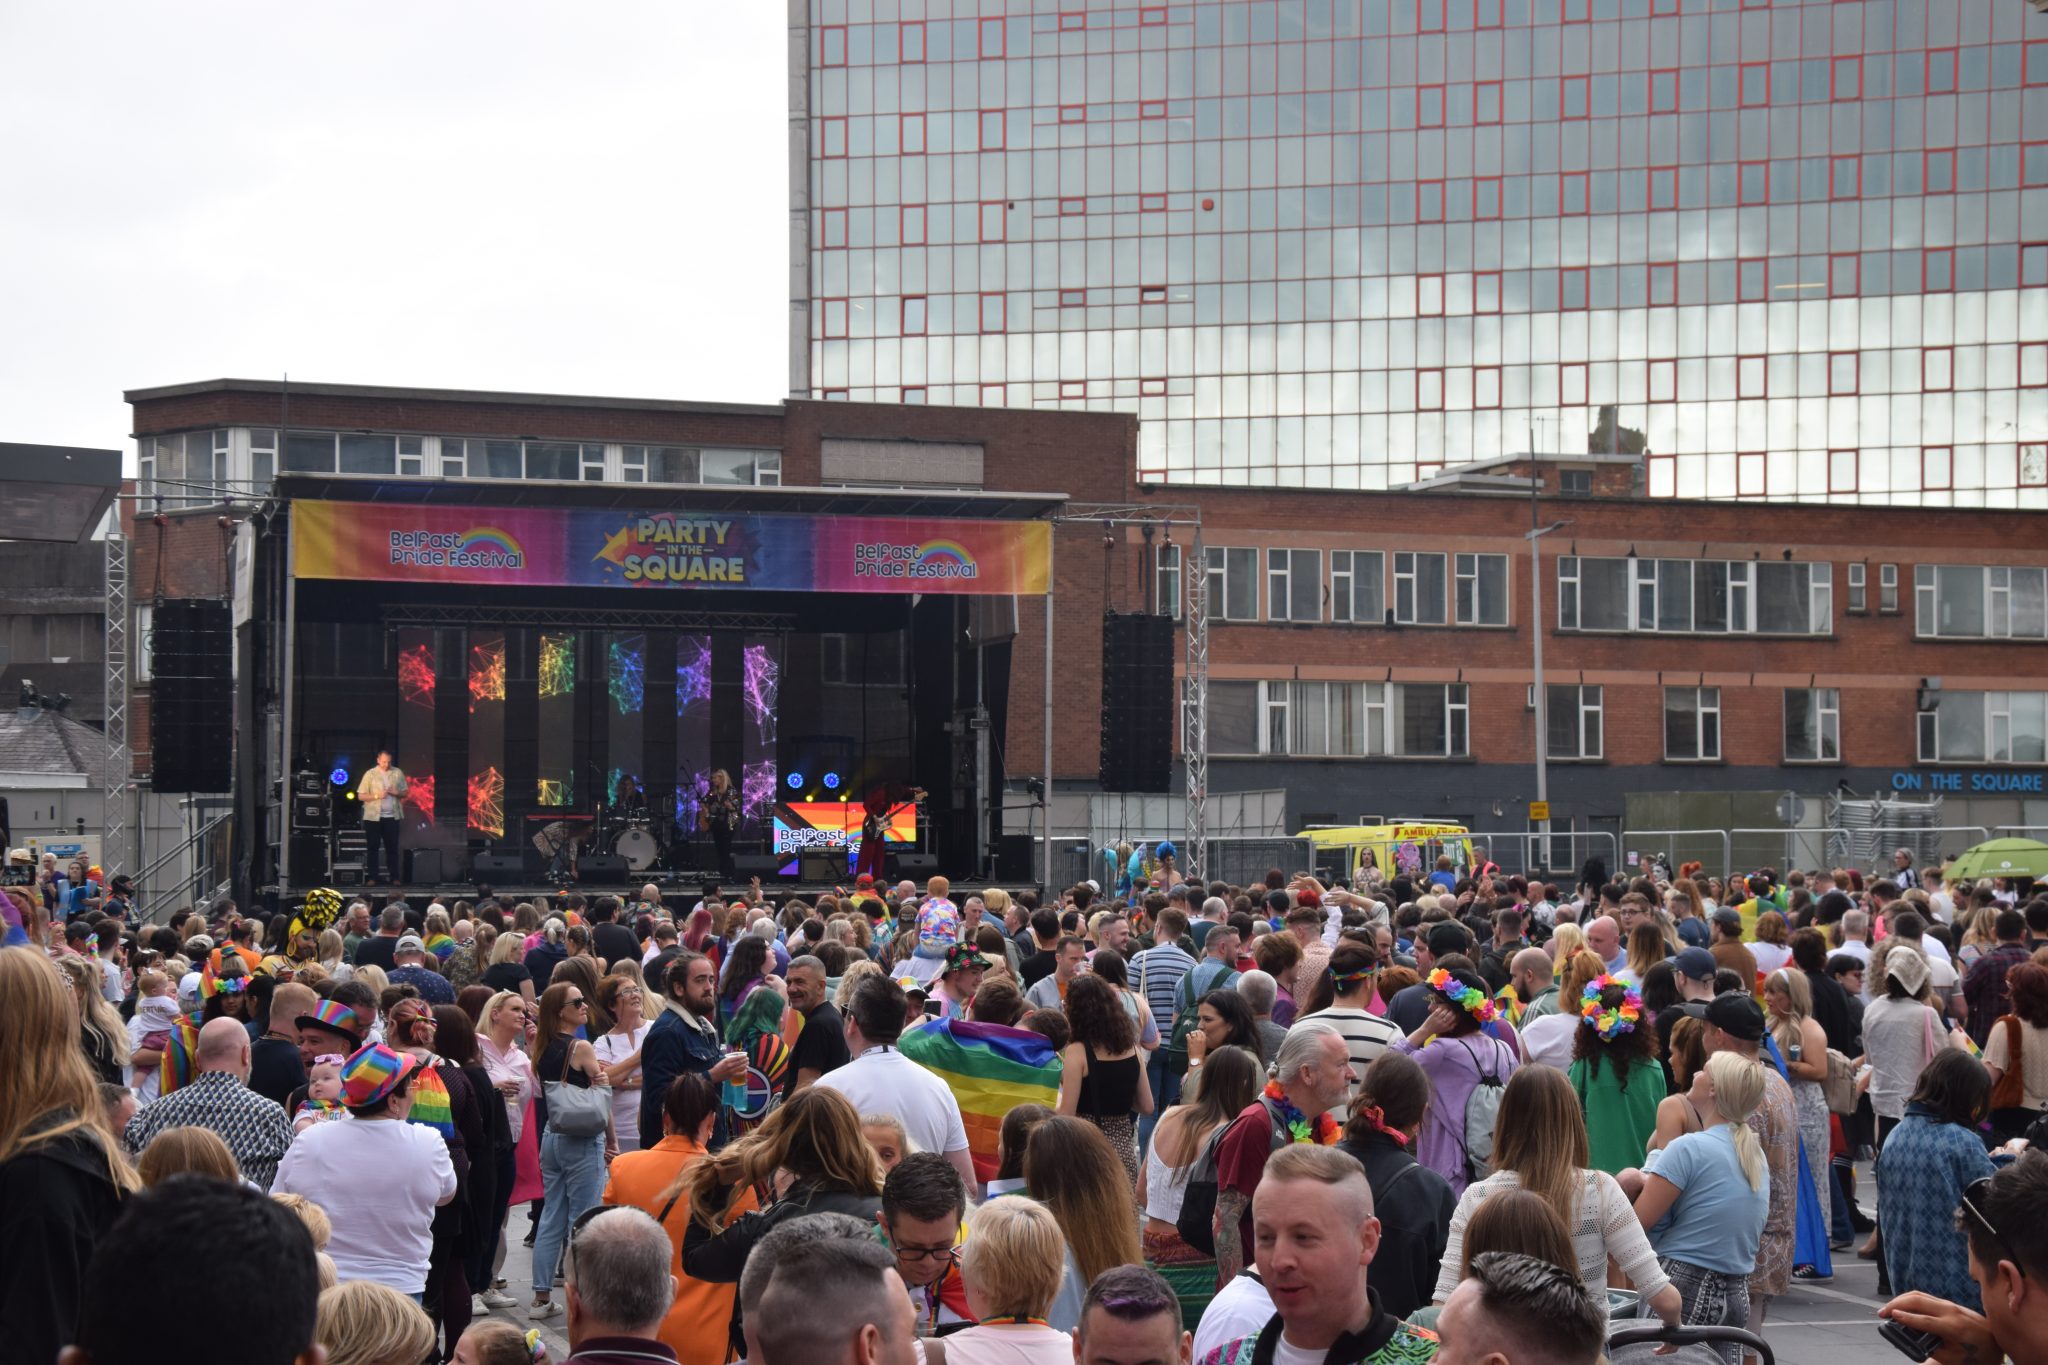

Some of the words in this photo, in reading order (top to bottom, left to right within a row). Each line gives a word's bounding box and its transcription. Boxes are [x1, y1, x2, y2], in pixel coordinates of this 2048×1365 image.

[390, 530, 465, 549] Belfast
[637, 518, 732, 545] PARTY
[391, 548, 445, 566] Pride
[448, 550, 523, 569] Festival
[667, 545, 679, 555] IN
[681, 545, 704, 556] THE
[855, 543, 923, 560] Belfast
[624, 555, 745, 581] SQUARE
[855, 560, 904, 577] Pride
[908, 561, 977, 579] Festival
[1892, 772, 1921, 790] ON
[1930, 773, 1962, 790] THE
[1971, 773, 2043, 791] SQUARE
[780, 828, 847, 841] Belfast
